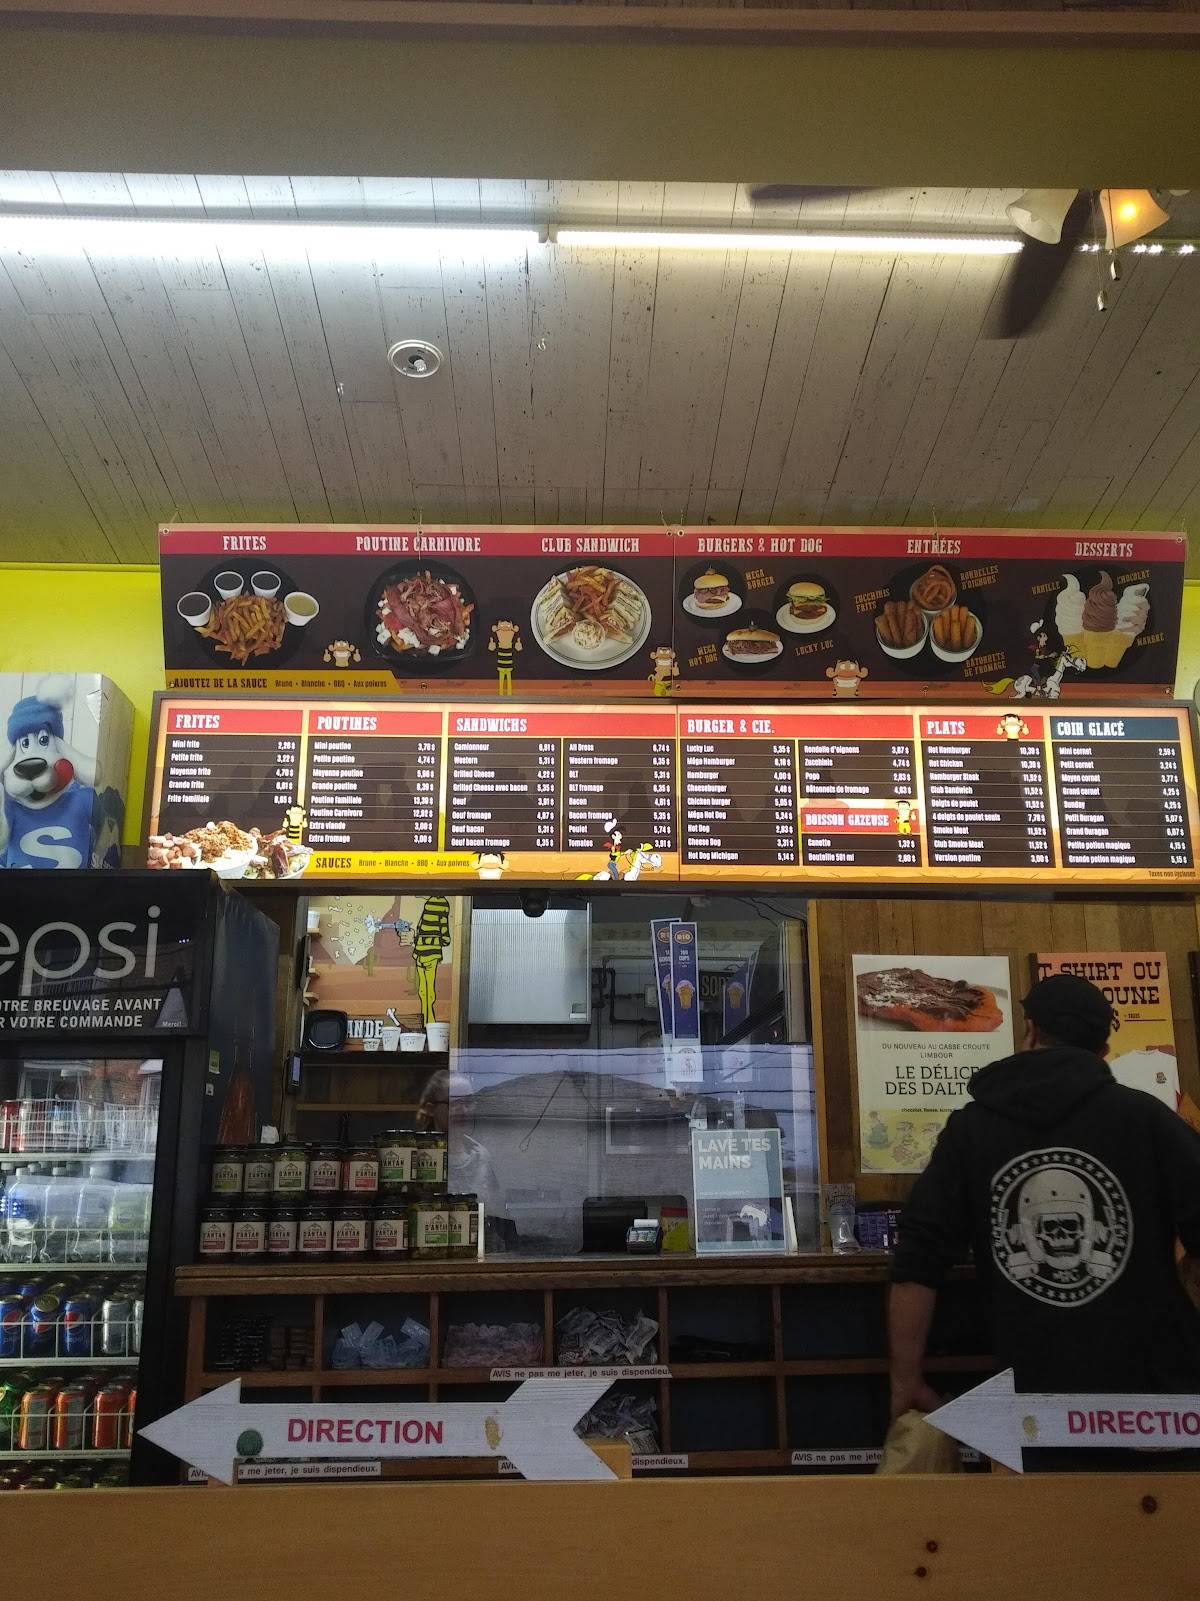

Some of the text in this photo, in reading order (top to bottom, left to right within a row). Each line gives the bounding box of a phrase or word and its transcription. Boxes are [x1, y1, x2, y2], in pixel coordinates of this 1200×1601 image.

[223, 536, 267, 551] FRITES
[356, 536, 481, 552] POUTINE CARNIVORE
[541, 538, 640, 552] CLUB SANDWICH
[698, 538, 823, 553] BURGERS & HOT DOG
[1075, 542, 1133, 558] DESSERTS
[746, 576, 775, 590] BURGER
[1117, 570, 1152, 585] CHOCOLAT
[1032, 581, 1060, 595] VANILLE
[174, 678, 268, 688] AJOUTEZ DE LA SAUCE
[176, 714, 220, 728] FRITES
[317, 716, 378, 730] POUTINES
[456, 718, 528, 732] SANDWICHS
[687, 719, 775, 734] BURGER & CIE.
[926, 720, 965, 735] PLATS
[1057, 720, 1124, 736] COIN GLACÉ
[805, 814, 890, 826] BOISSON GAZEUSE
[316, 858, 352, 868] SAUCES
[1060, 962, 1122, 981] SHIRT
[1134, 962, 1161, 980] OU
[0, 998, 162, 1011] TRE BREUVAGE AVANT
[10, 1015, 143, 1028] VOTRE COMMANDE
[895, 1066, 915, 1079] LE
[885, 1082, 969, 1095] DES DALT
[698, 1138, 771, 1152] LAVE TES
[700, 1155, 751, 1169] MAINS
[493, 1370, 511, 1378] AVIS
[564, 1370, 586, 1378] jeter,
[589, 1369, 597, 1378] je
[288, 1418, 444, 1444] DIRECTION
[632, 1456, 686, 1466] dispendieux.
[794, 1453, 813, 1462] AVIS
[264, 1467, 287, 1476] jeter,
[290, 1467, 298, 1476] je
[303, 1466, 319, 1474] suis
[323, 1464, 378, 1474] dispendieux.
